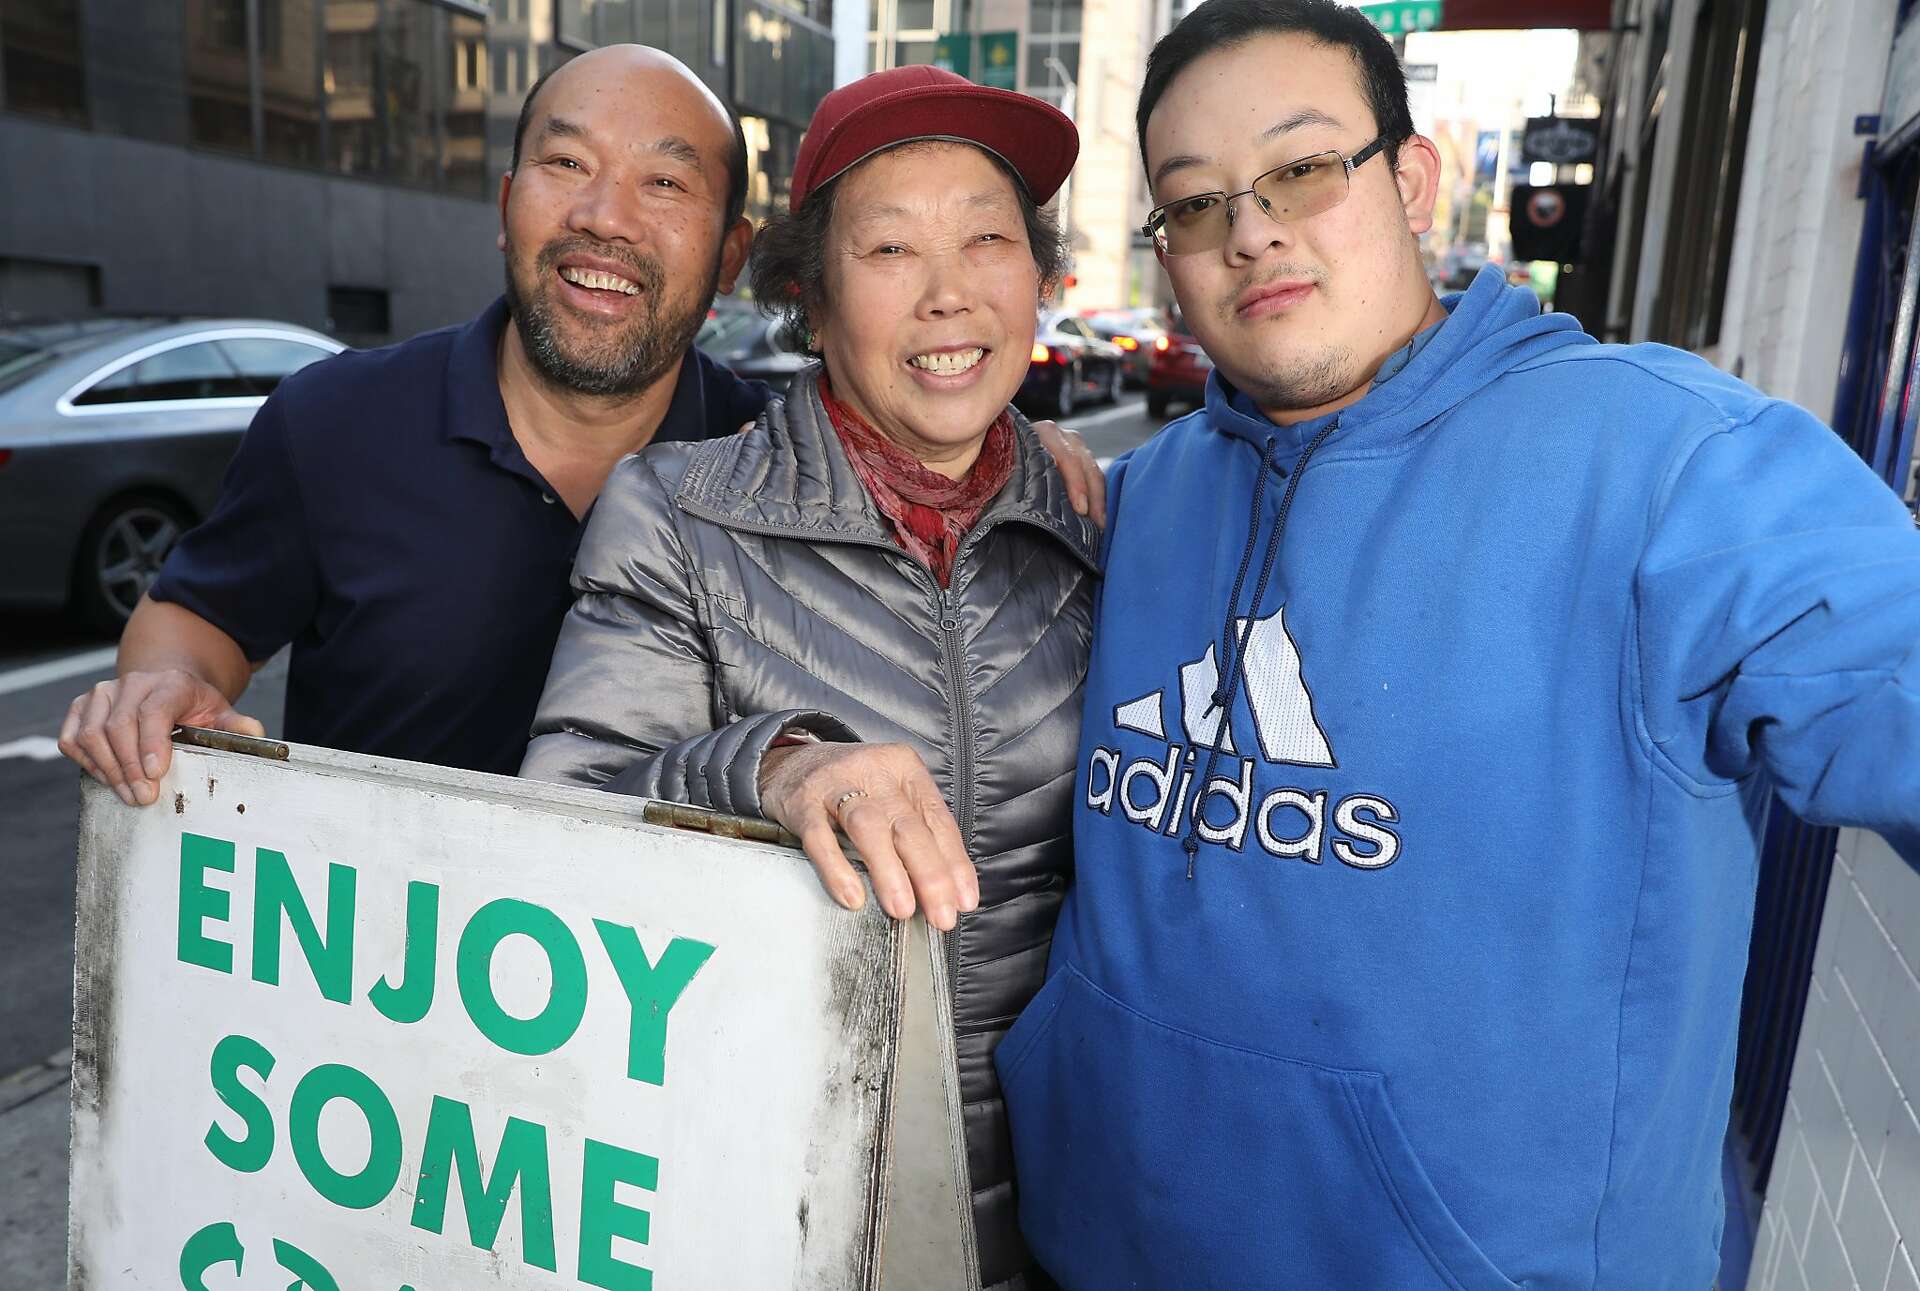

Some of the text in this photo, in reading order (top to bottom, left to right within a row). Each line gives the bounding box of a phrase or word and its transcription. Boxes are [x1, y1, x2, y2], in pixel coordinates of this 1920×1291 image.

[1086, 744, 1402, 870] adidas
[177, 832, 718, 1087] ENJOY
[203, 1034, 660, 1291] SOME
